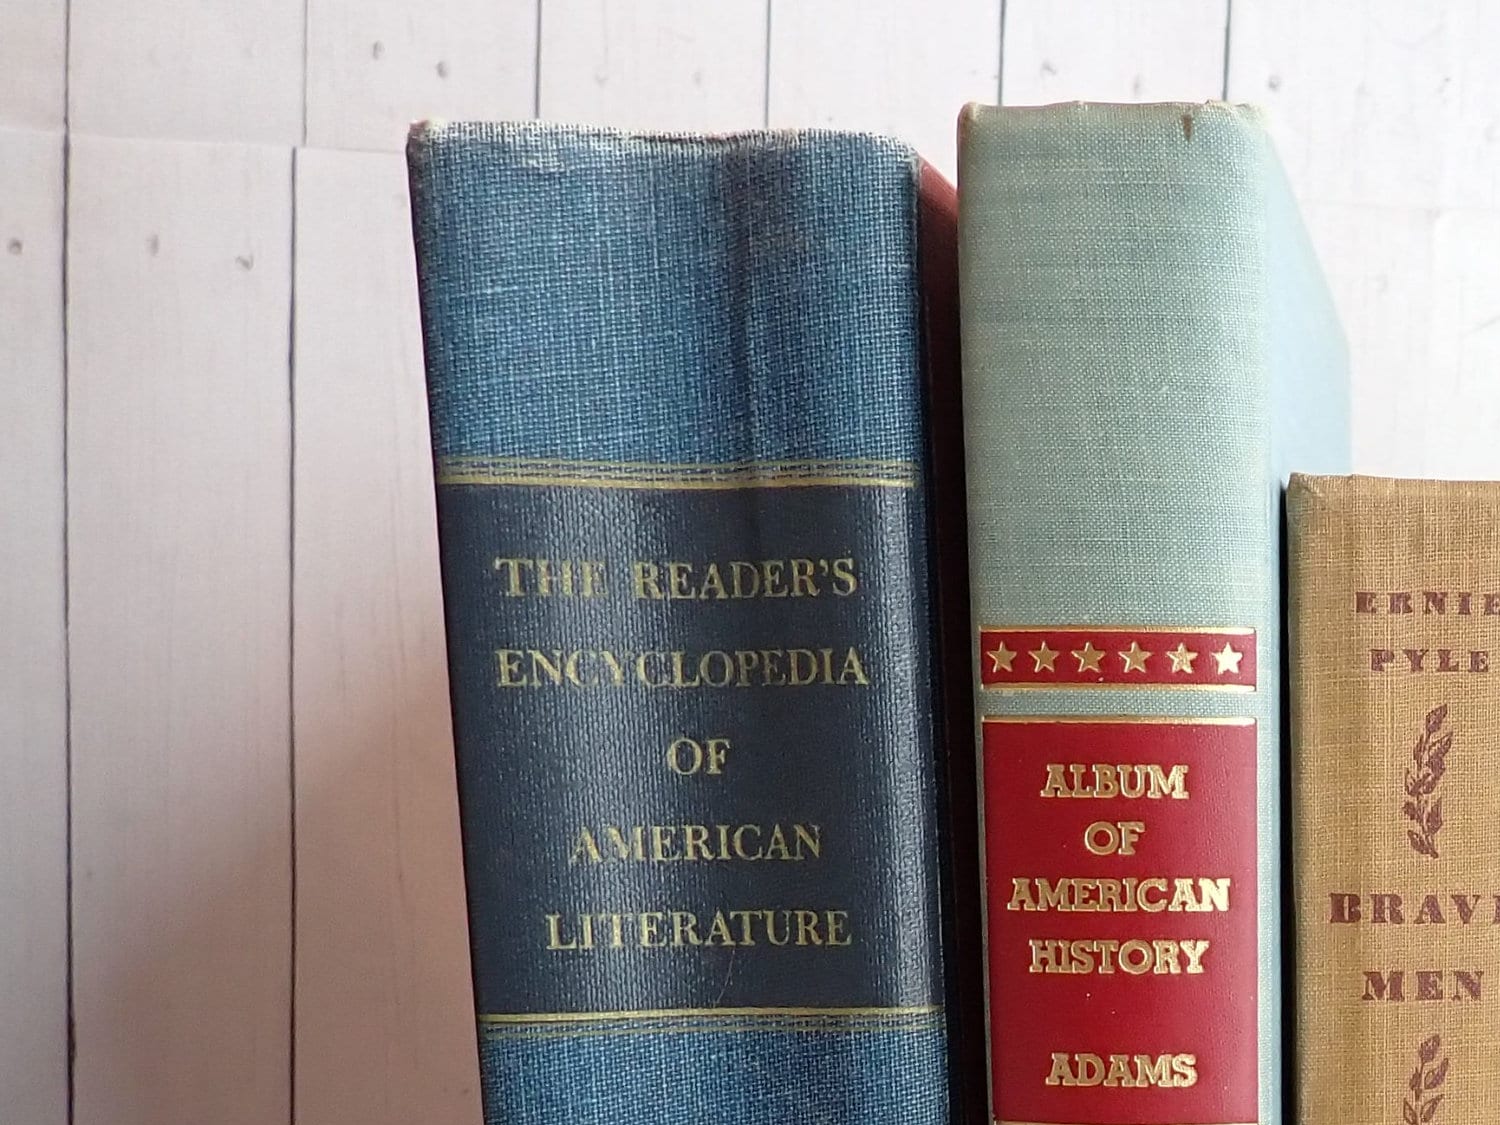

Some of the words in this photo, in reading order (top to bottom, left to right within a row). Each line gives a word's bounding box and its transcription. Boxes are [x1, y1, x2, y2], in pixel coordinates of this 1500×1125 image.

[495, 557, 606, 598] THE
[633, 556, 859, 600] READER'S
[496, 646, 870, 688] ENCYCLOPEDIA
[1370, 649, 1489, 673] PYLE
[666, 739, 731, 776] OF
[1040, 764, 1190, 800] ALBUM
[568, 824, 823, 865] AMERICAN
[1084, 821, 1145, 855] OF
[1007, 877, 1231, 912] AMERICAN
[545, 910, 853, 951] LITERATURE
[1029, 938, 1210, 974] HISTORY
[1362, 971, 1485, 1002] MEN
[1045, 1052, 1198, 1087] ADAMS
